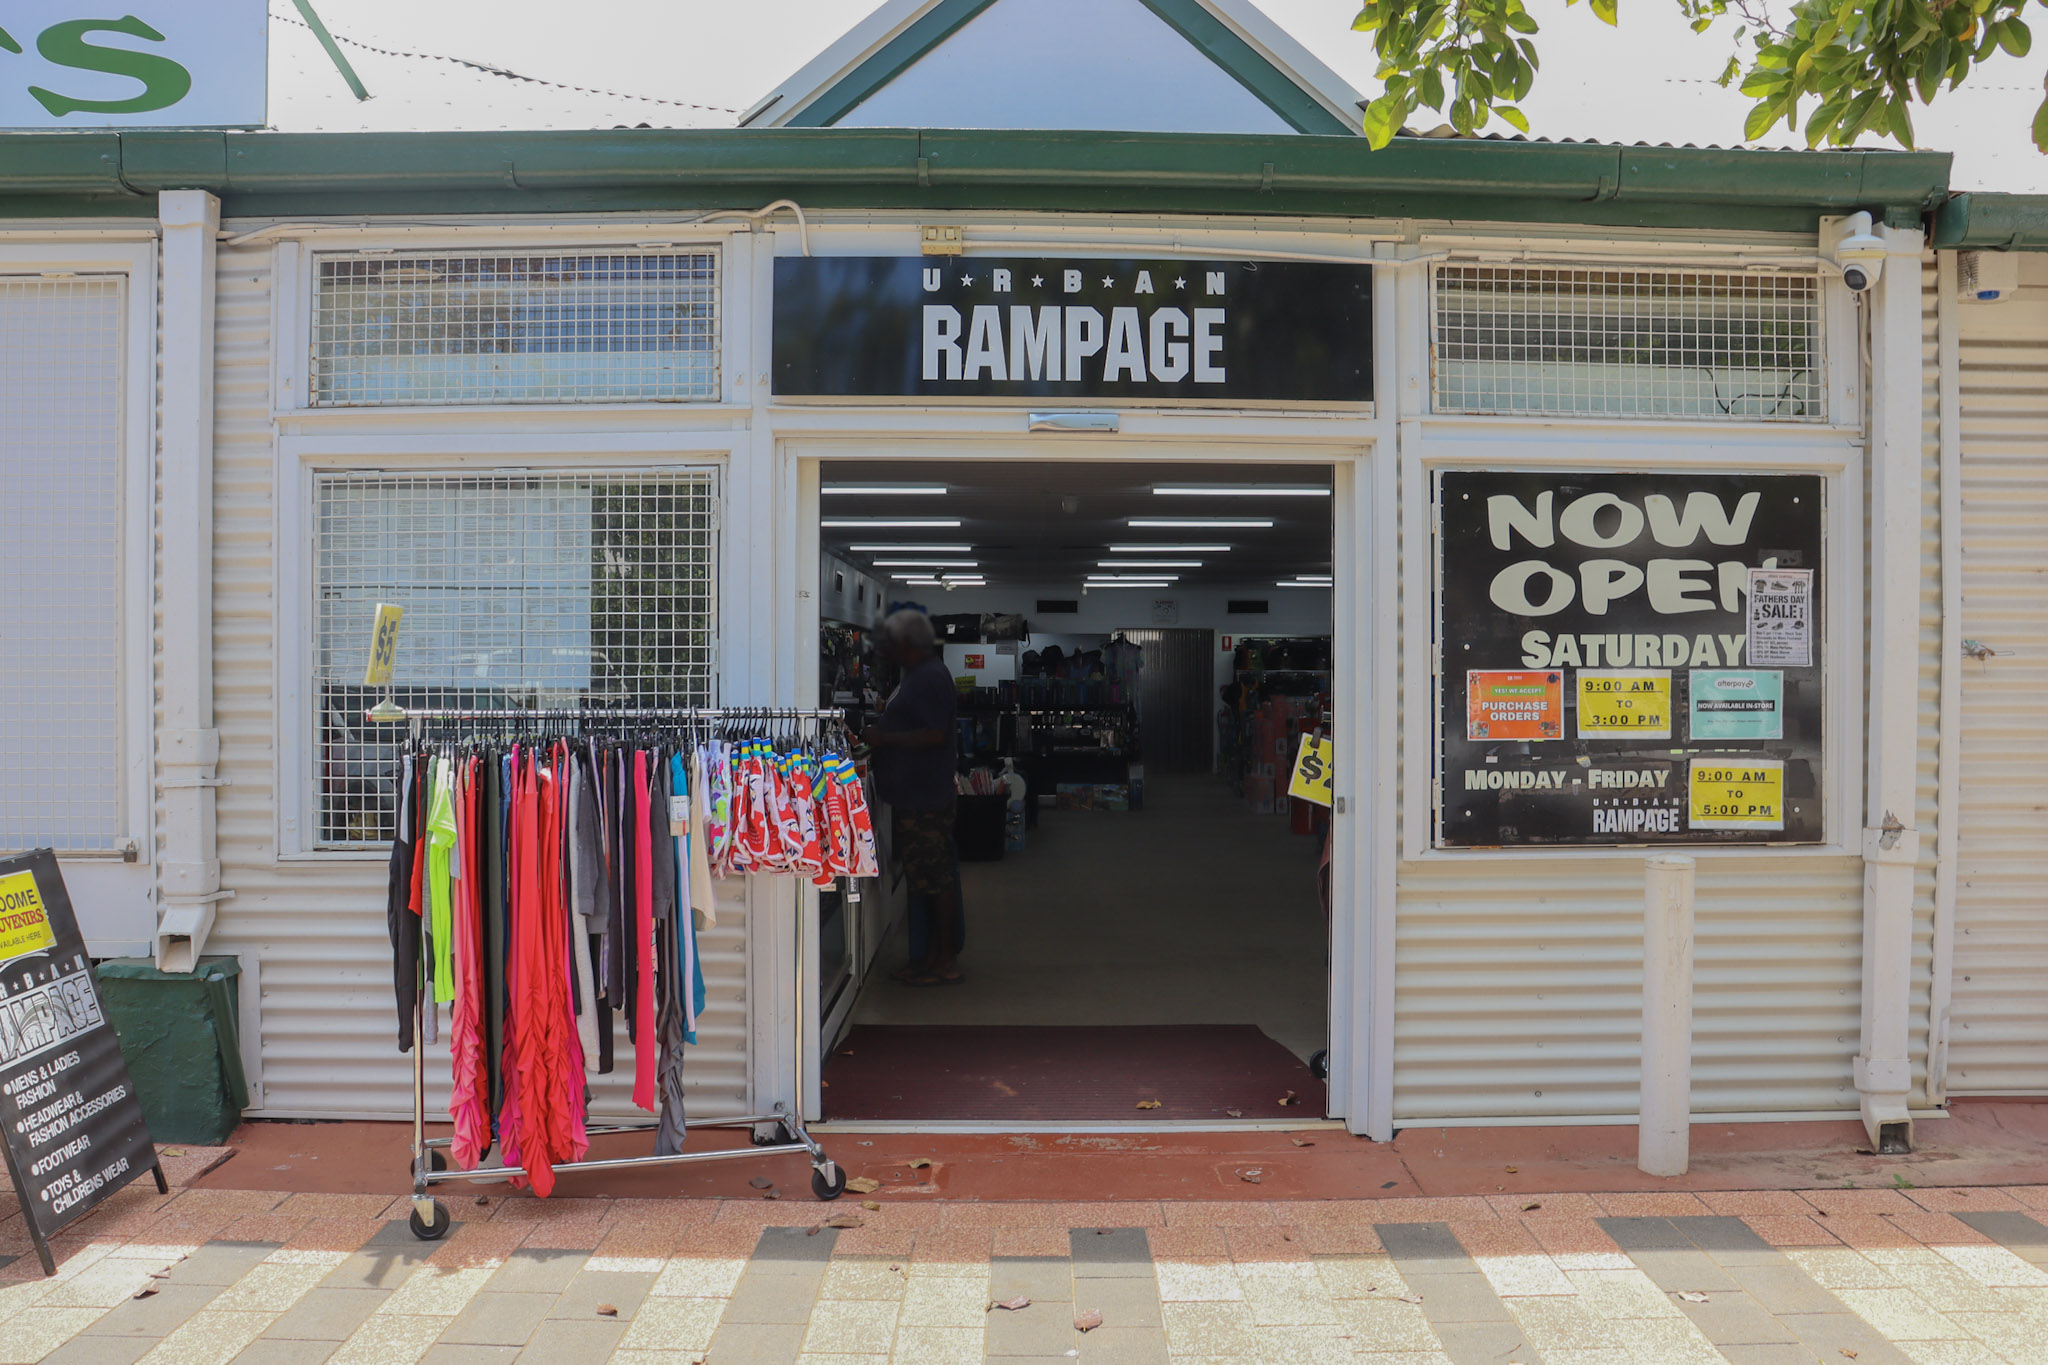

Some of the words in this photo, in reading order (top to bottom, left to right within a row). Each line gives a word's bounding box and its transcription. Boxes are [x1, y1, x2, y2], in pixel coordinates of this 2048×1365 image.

[0, 14, 192, 117] S
[922, 304, 1226, 383] RAMPAGE
[1487, 490, 1762, 551] NOW
[1754, 595, 1789, 604] FATHERS
[1790, 595, 1805, 604] DAY
[1761, 604, 1797, 619] SALE
[375, 616, 397, 670] $5
[1521, 630, 1748, 669] SATURDAY
[1585, 681, 1622, 691] 9:00
[1631, 681, 1655, 691] AM
[1717, 680, 1746, 688] afterpay
[1481, 701, 1548, 711] PURCHASE
[1616, 700, 1633, 709] TO
[1490, 712, 1540, 721] ORDERS
[1592, 715, 1629, 725] 3:00
[1638, 715, 1660, 725] PM
[1465, 769, 1567, 791] MONDAY
[1588, 768, 1670, 789] FRIDAY
[1697, 771, 1733, 782] 9:00
[1742, 772, 1766, 782] AM
[1727, 790, 1744, 798] TO
[1593, 808, 1679, 833] RAMPAGE
[1703, 805, 1739, 815] 5:00
[1748, 805, 1772, 816] PM
[26, 930, 42, 941] HERE
[10, 1070, 39, 1094] MENS
[40, 1066, 48, 1080] &
[47, 1050, 81, 1075] LADIES
[15, 1079, 57, 1110] FASHION
[28, 1119, 70, 1148] FASHION
[70, 1085, 127, 1127] ACCESSORIES
[37, 1134, 91, 1175] FOOTWEAR
[47, 1174, 73, 1199] TOYS
[73, 1169, 82, 1182] &
[53, 1173, 104, 1214] CHILDRENS
[102, 1157, 130, 1183] WEAR
